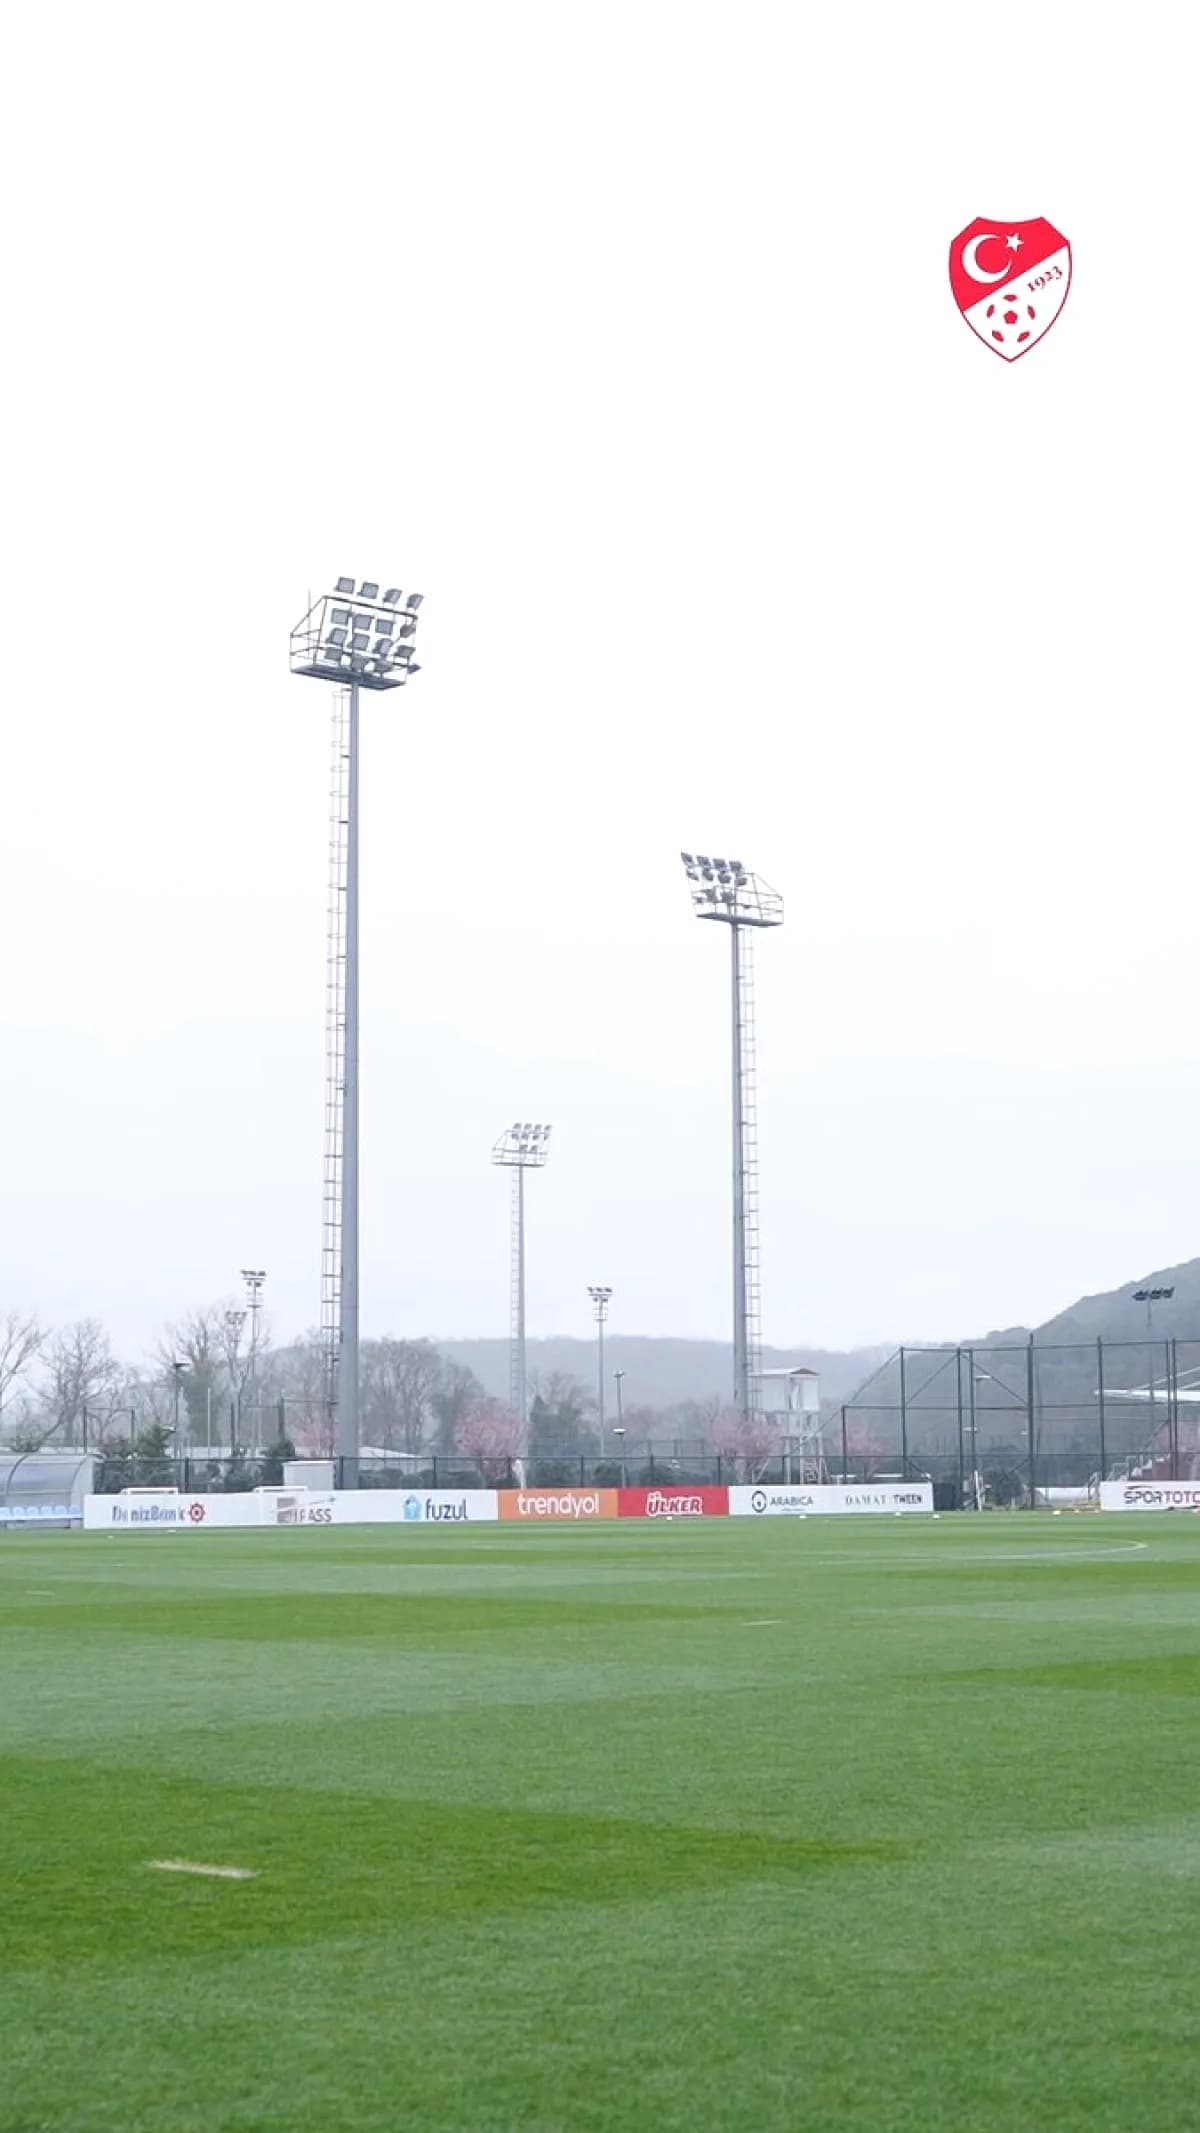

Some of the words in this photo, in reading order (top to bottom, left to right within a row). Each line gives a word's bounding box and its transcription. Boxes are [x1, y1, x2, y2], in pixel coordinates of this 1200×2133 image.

[425, 1498, 468, 1520] fuzul
[517, 1492, 600, 1518] trendyol
[647, 1491, 702, 1515] ÜLKER
